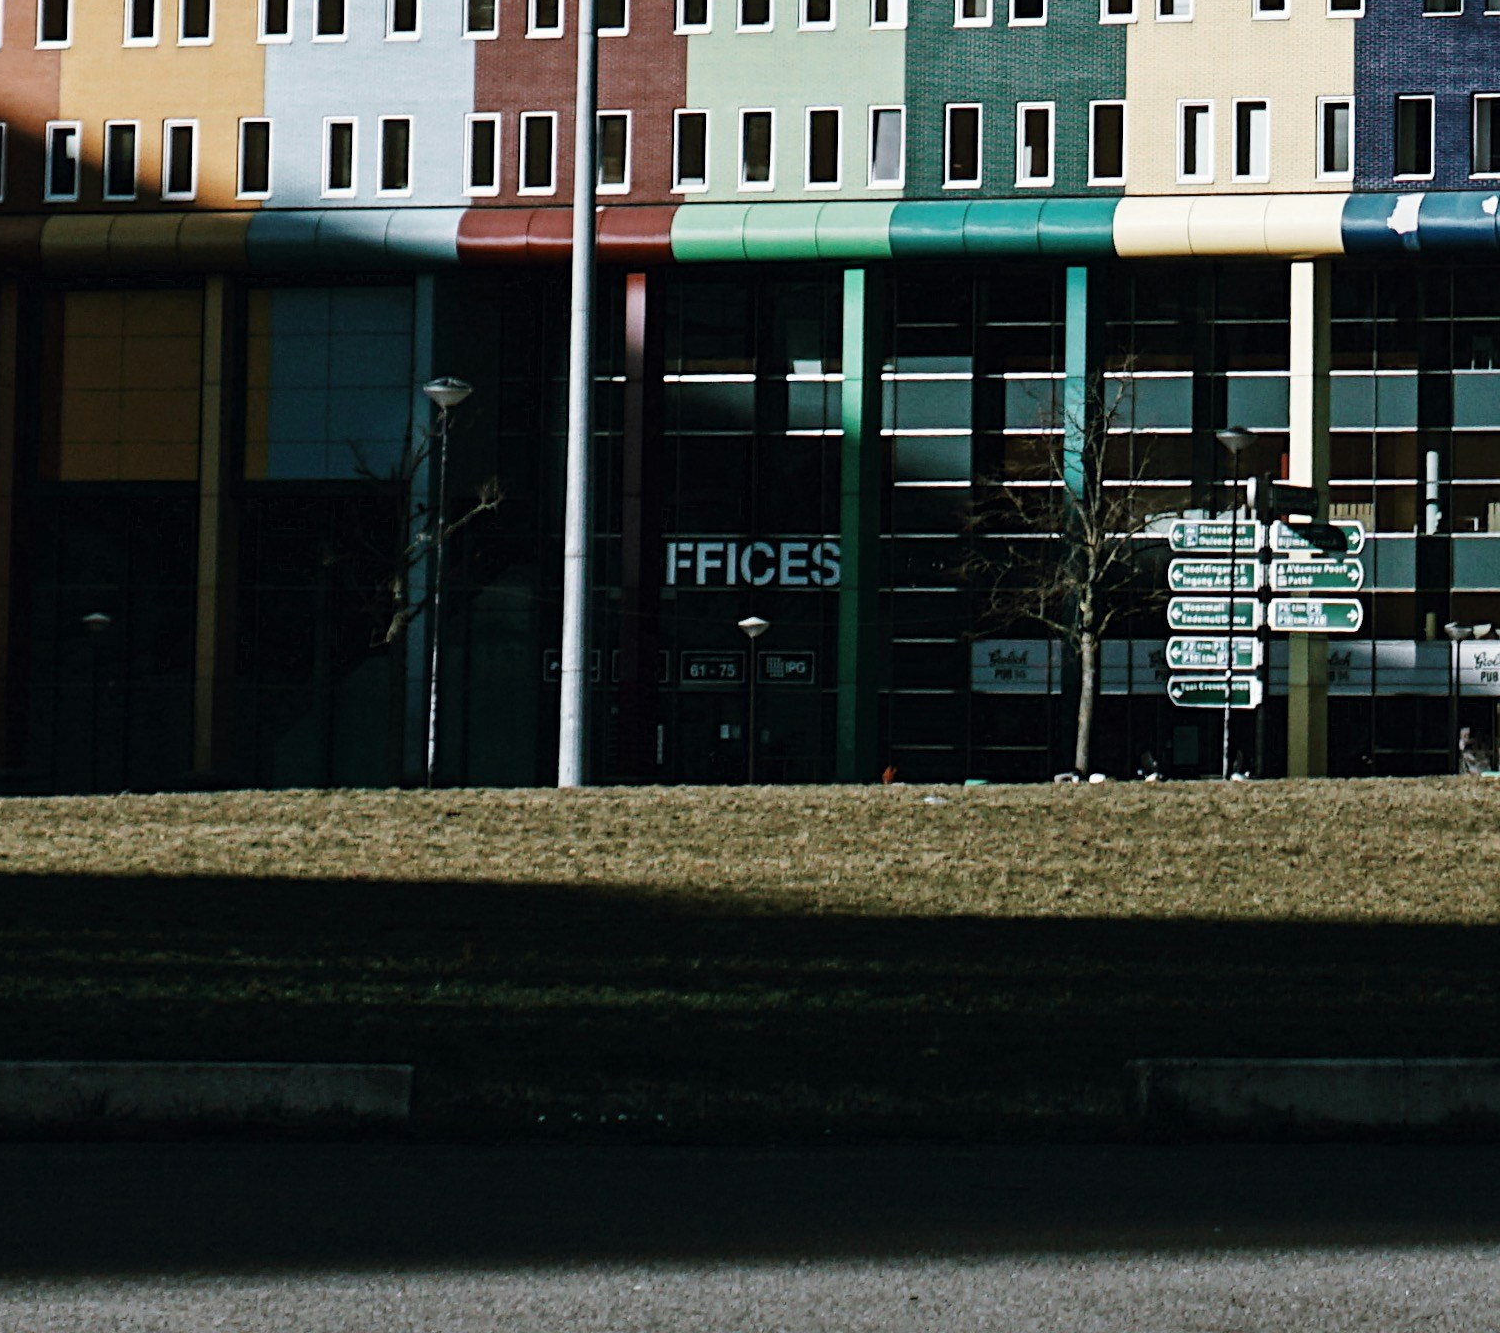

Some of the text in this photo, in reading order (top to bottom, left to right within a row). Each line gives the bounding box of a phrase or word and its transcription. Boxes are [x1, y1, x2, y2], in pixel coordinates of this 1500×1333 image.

[665, 541, 842, 587] FFICES
[689, 662, 706, 678] 61
[1481, 671, 1499, 682] PUB
